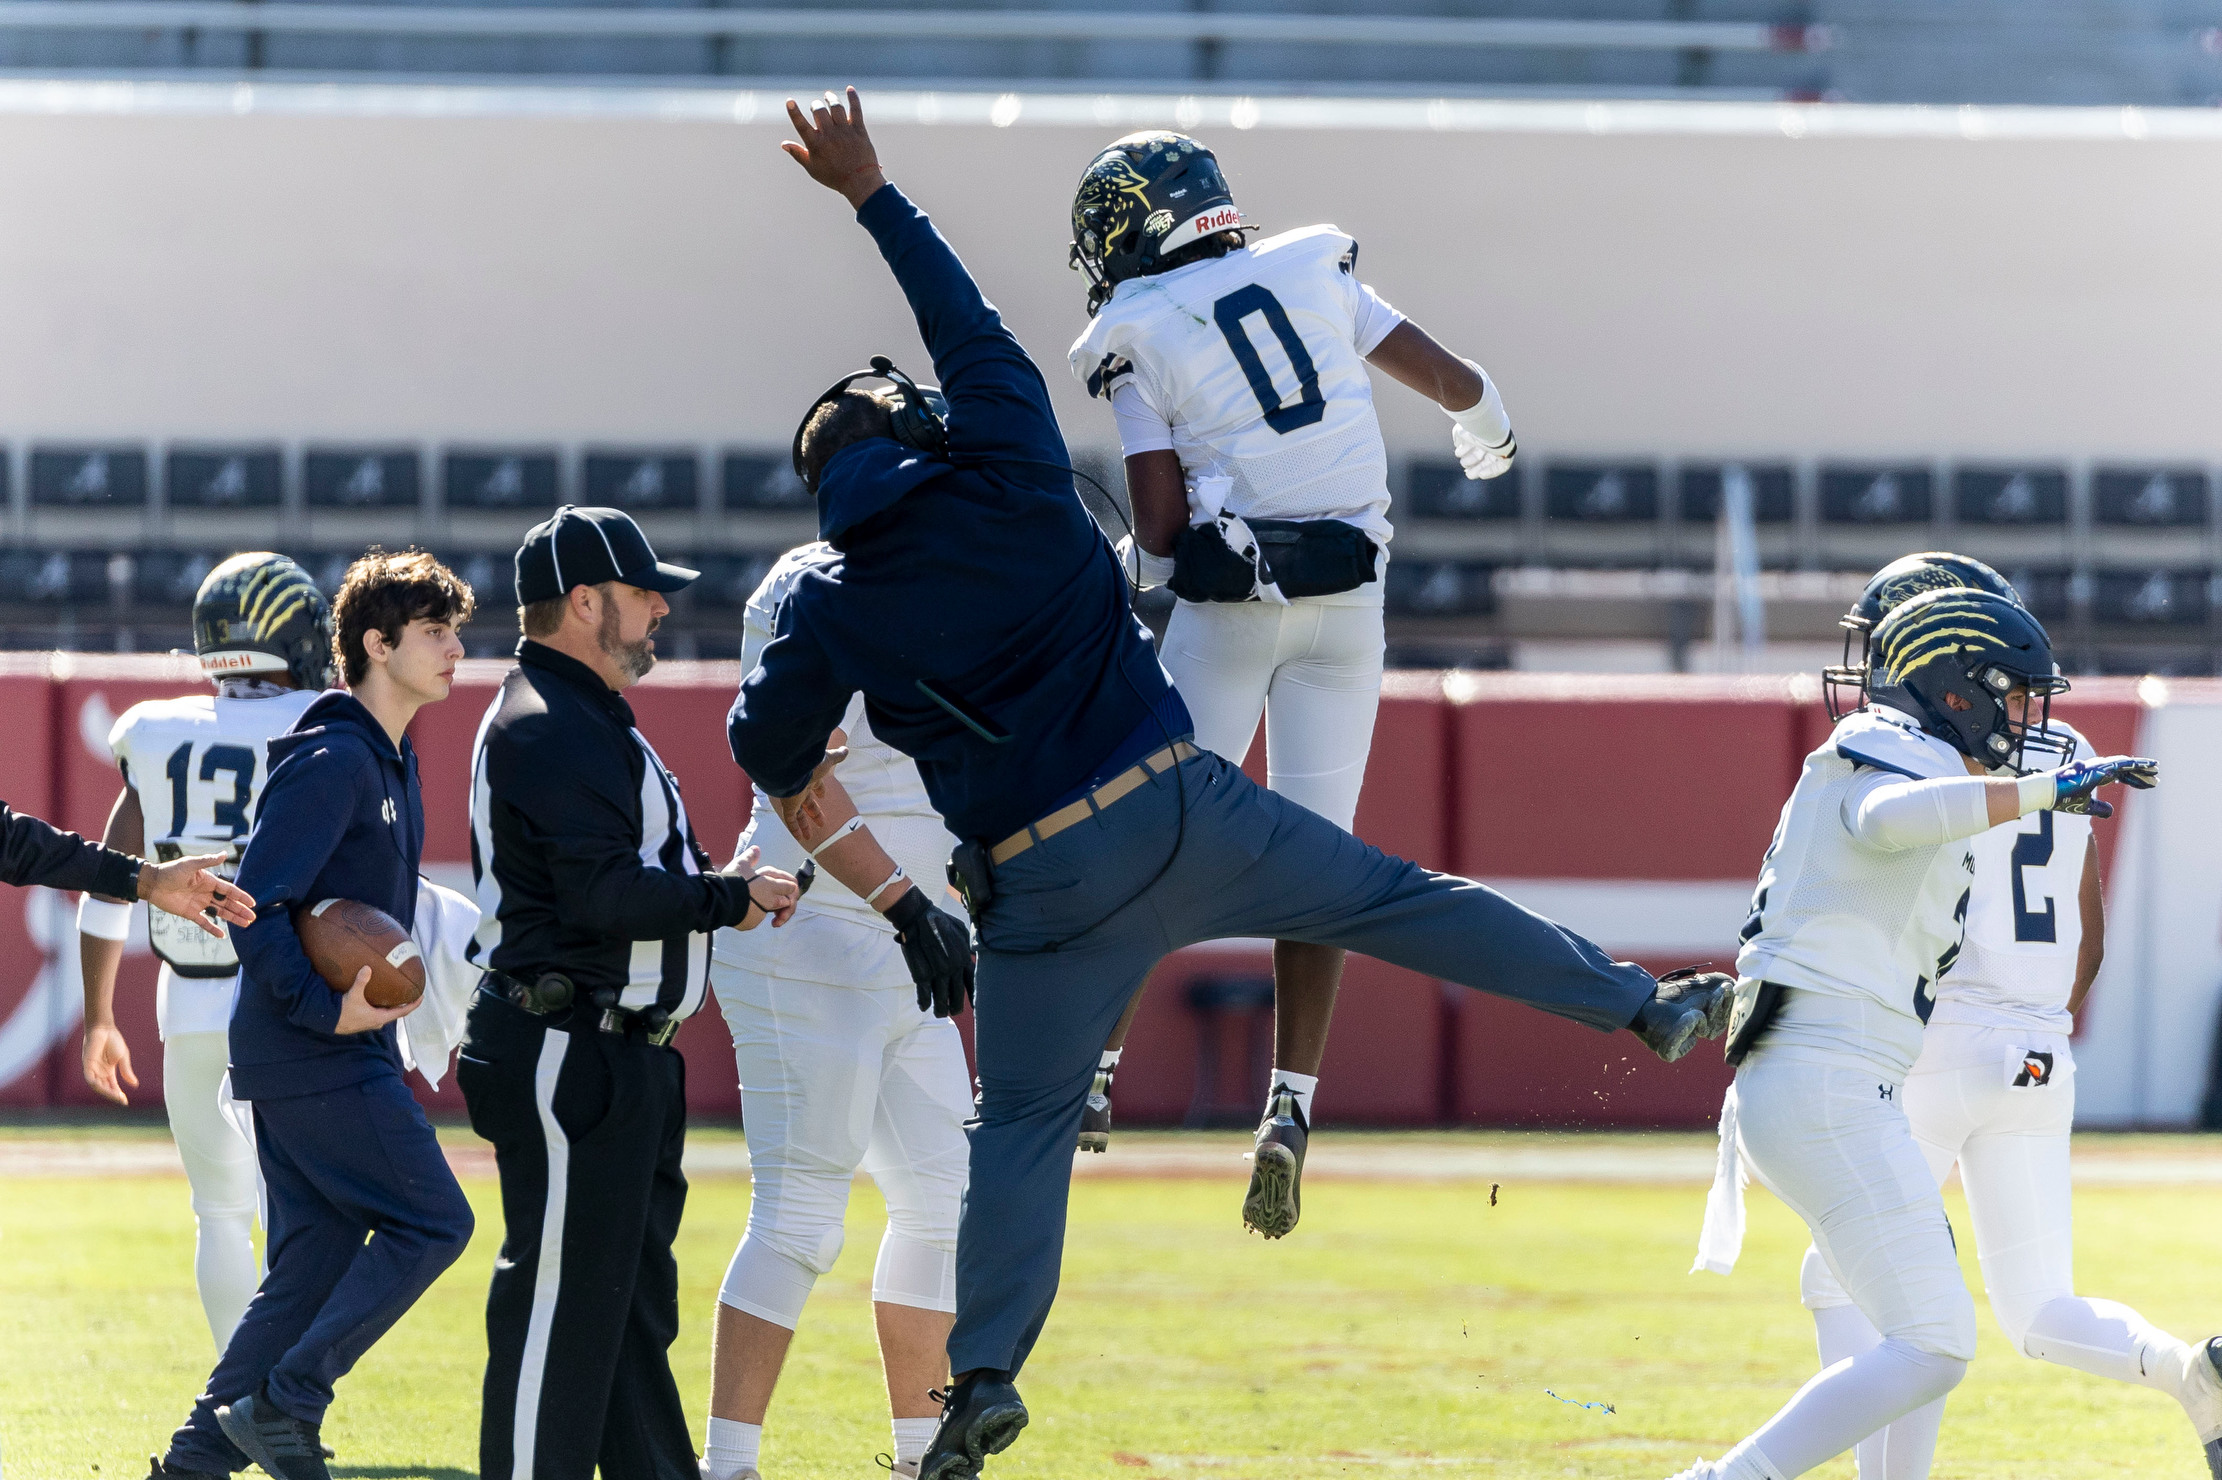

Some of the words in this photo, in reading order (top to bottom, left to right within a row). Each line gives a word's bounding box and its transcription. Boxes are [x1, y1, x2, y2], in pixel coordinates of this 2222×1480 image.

[1195, 209, 1239, 234] Ridde
[1213, 283, 1326, 435] 0
[166, 741, 256, 841] 13
[2011, 809, 2057, 943] 2
